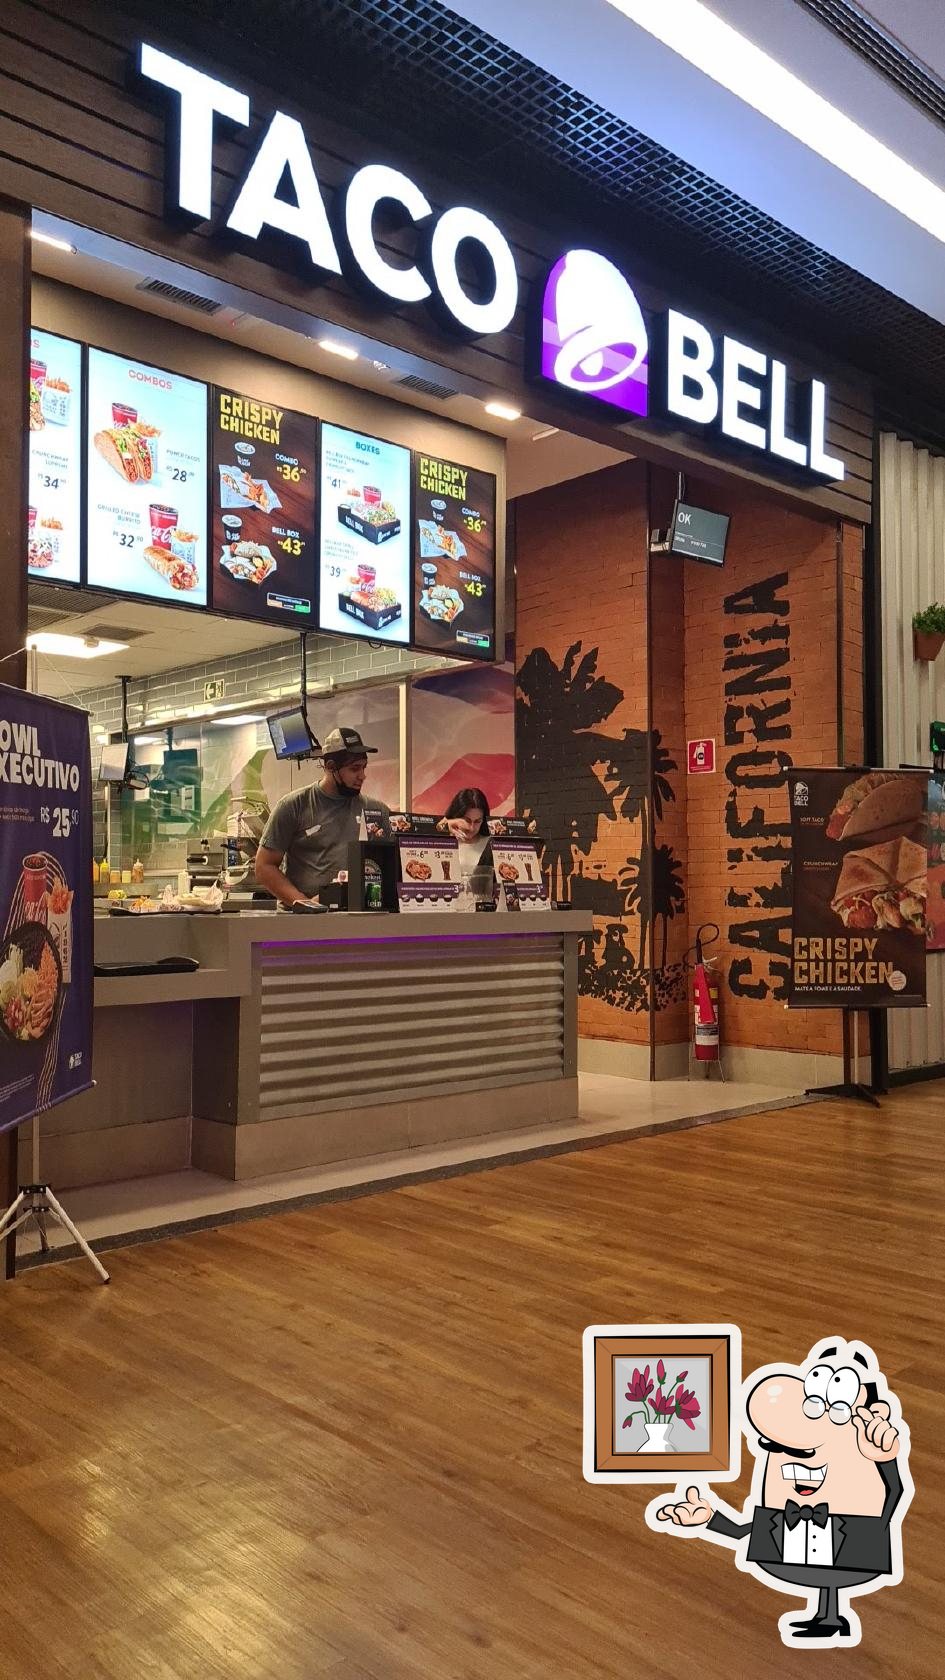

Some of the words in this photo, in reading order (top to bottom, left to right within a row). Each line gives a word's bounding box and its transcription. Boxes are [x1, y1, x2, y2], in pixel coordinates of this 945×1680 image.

[140, 41, 519, 334] TACO
[667, 308, 845, 481] BELL
[128, 369, 173, 390] COMBOS
[220, 394, 283, 431] CRISPY
[220, 414, 280, 445] CHICKEN
[275, 453, 299, 465] COMBO
[355, 441, 381, 456] BOXES
[420, 457, 468, 487] CRISPY
[420, 475, 466, 501] CHICKEN
[461, 507, 481, 518] COMBO
[677, 511, 692, 526] OK
[0, 719, 41, 757] OWL
[724, 571, 793, 1001] CALIFORNIA
[40, 806, 50, 824] R$
[793, 937, 878, 960] CRISPY
[793, 961, 893, 984] CHICKEN
